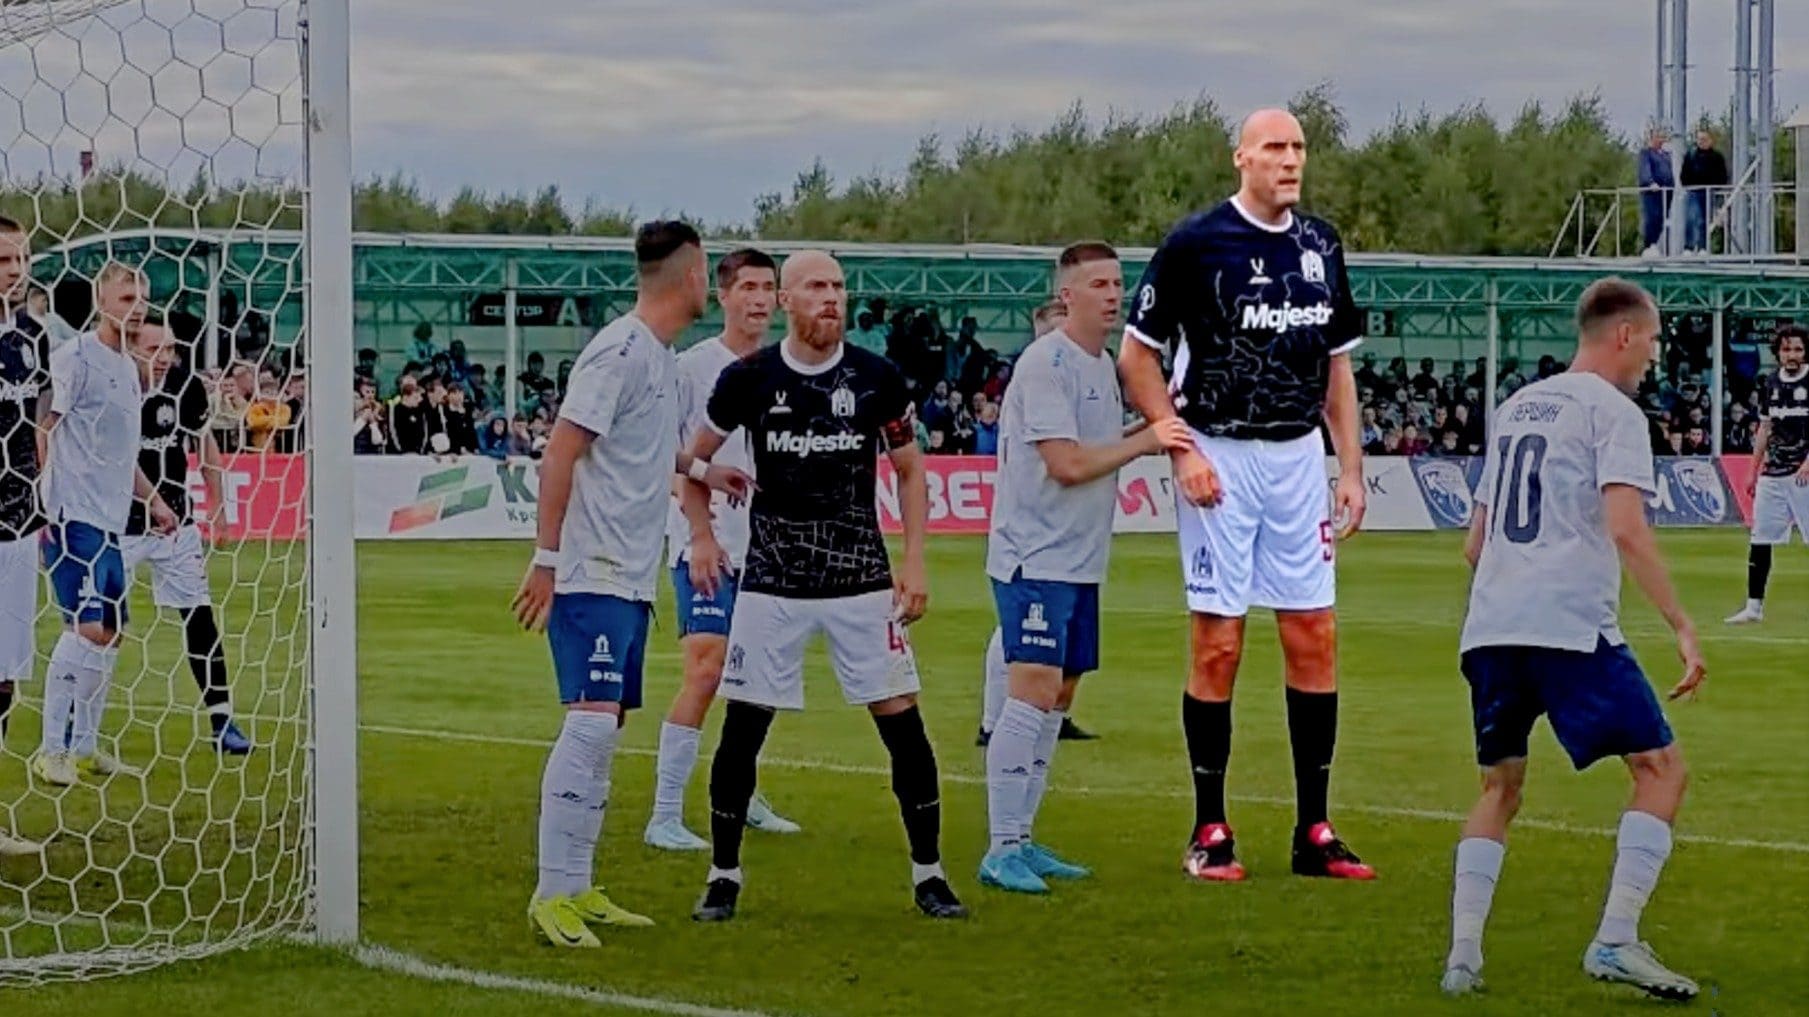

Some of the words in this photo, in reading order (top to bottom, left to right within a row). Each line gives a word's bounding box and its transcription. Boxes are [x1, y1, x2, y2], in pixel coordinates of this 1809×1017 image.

[767, 429, 866, 458] Majestic
[1489, 433, 1548, 543] 10
[1319, 520, 1333, 562] 5
